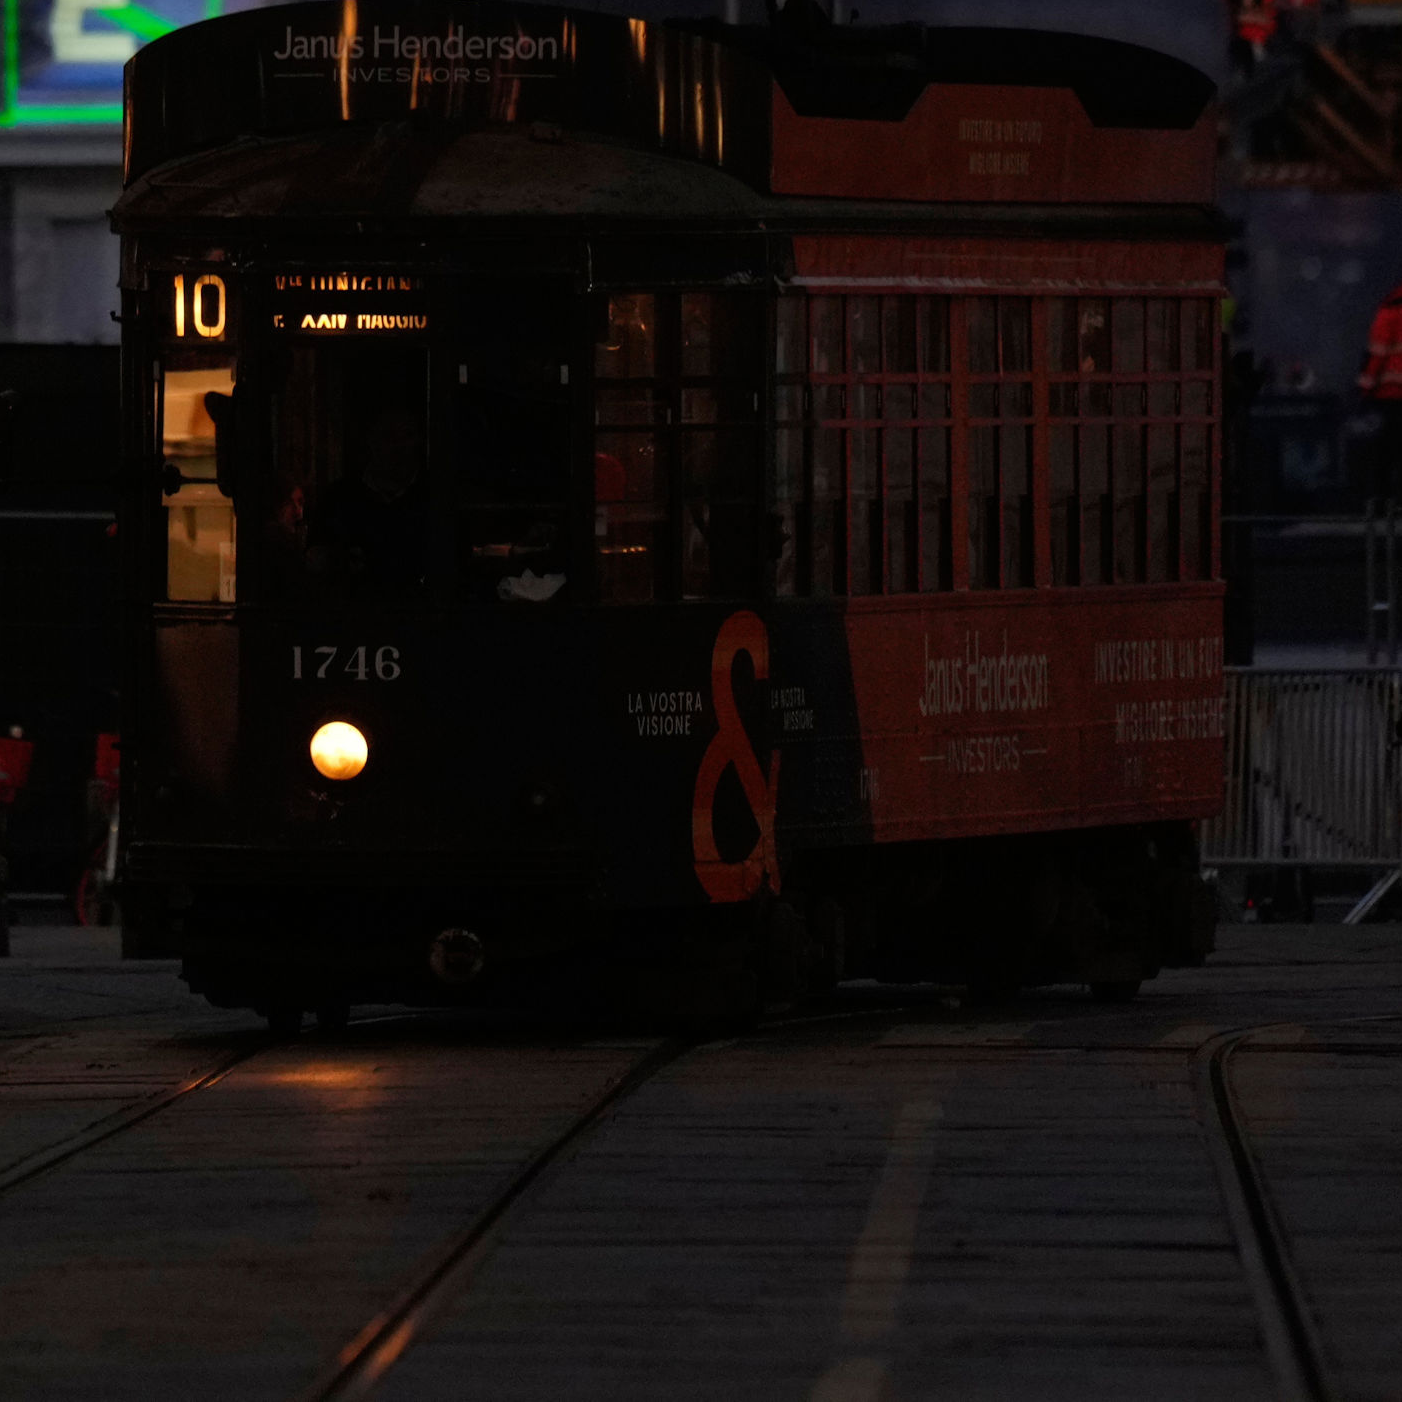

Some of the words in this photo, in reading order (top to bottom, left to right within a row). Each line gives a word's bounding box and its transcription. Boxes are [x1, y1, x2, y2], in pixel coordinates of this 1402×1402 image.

[273, 24, 364, 60] Janus
[373, 24, 558, 60] Henderson
[333, 67, 491, 84] INVESTORS
[173, 272, 227, 338] 10
[291, 645, 402, 681] 1746
[919, 632, 963, 717] Janus
[965, 628, 1049, 713] Henderson
[1094, 638, 1158, 684] INVESTIRE
[1160, 637, 1174, 680] IN
[1178, 637, 1195, 679] UN
[627, 692, 644, 714] LA
[648, 691, 703, 713] VOSTRA
[1114, 698, 1175, 744] MIGLIORE
[636, 714, 692, 736] VISIONE
[946, 733, 1021, 774] INVESTORS
